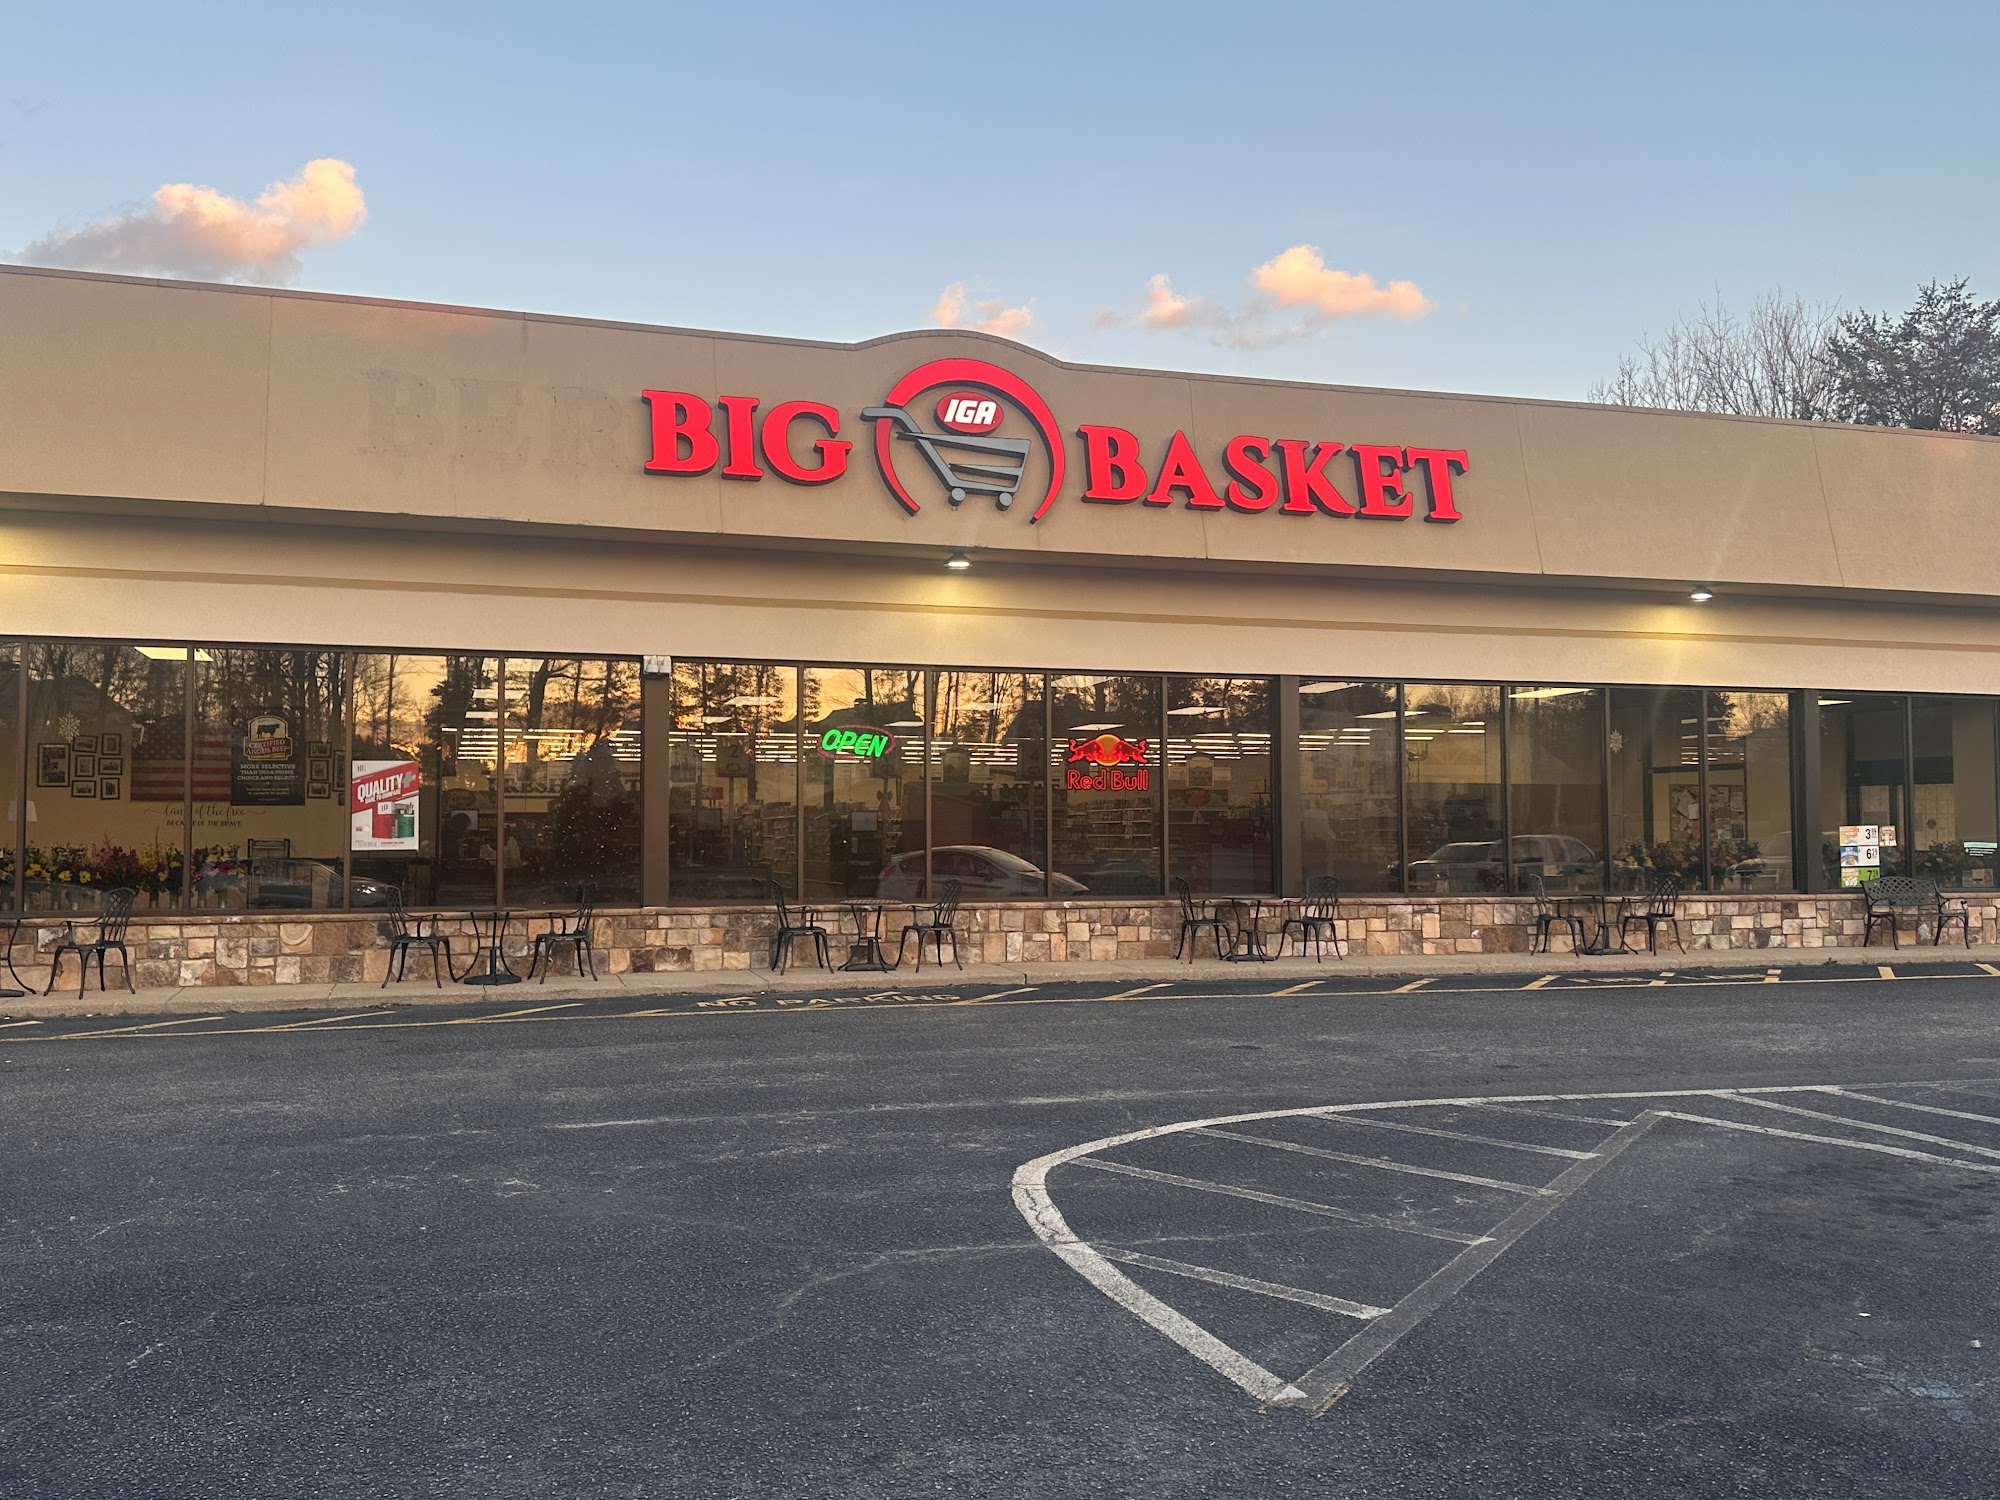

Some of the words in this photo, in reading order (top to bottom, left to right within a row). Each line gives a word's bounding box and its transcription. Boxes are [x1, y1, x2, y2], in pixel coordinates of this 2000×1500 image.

[943, 398, 997, 425] IGA
[641, 389, 853, 486] BIG
[1076, 424, 1470, 524] BASKET
[246, 747, 271, 755] ANGUS
[248, 739, 286, 749] CERTIFIED
[821, 729, 889, 758] OPEN
[1067, 768, 1107, 790] Red
[1110, 769, 1149, 791] Bull
[696, 1000, 757, 1008] NO
[776, 993, 961, 1007] PARKING
